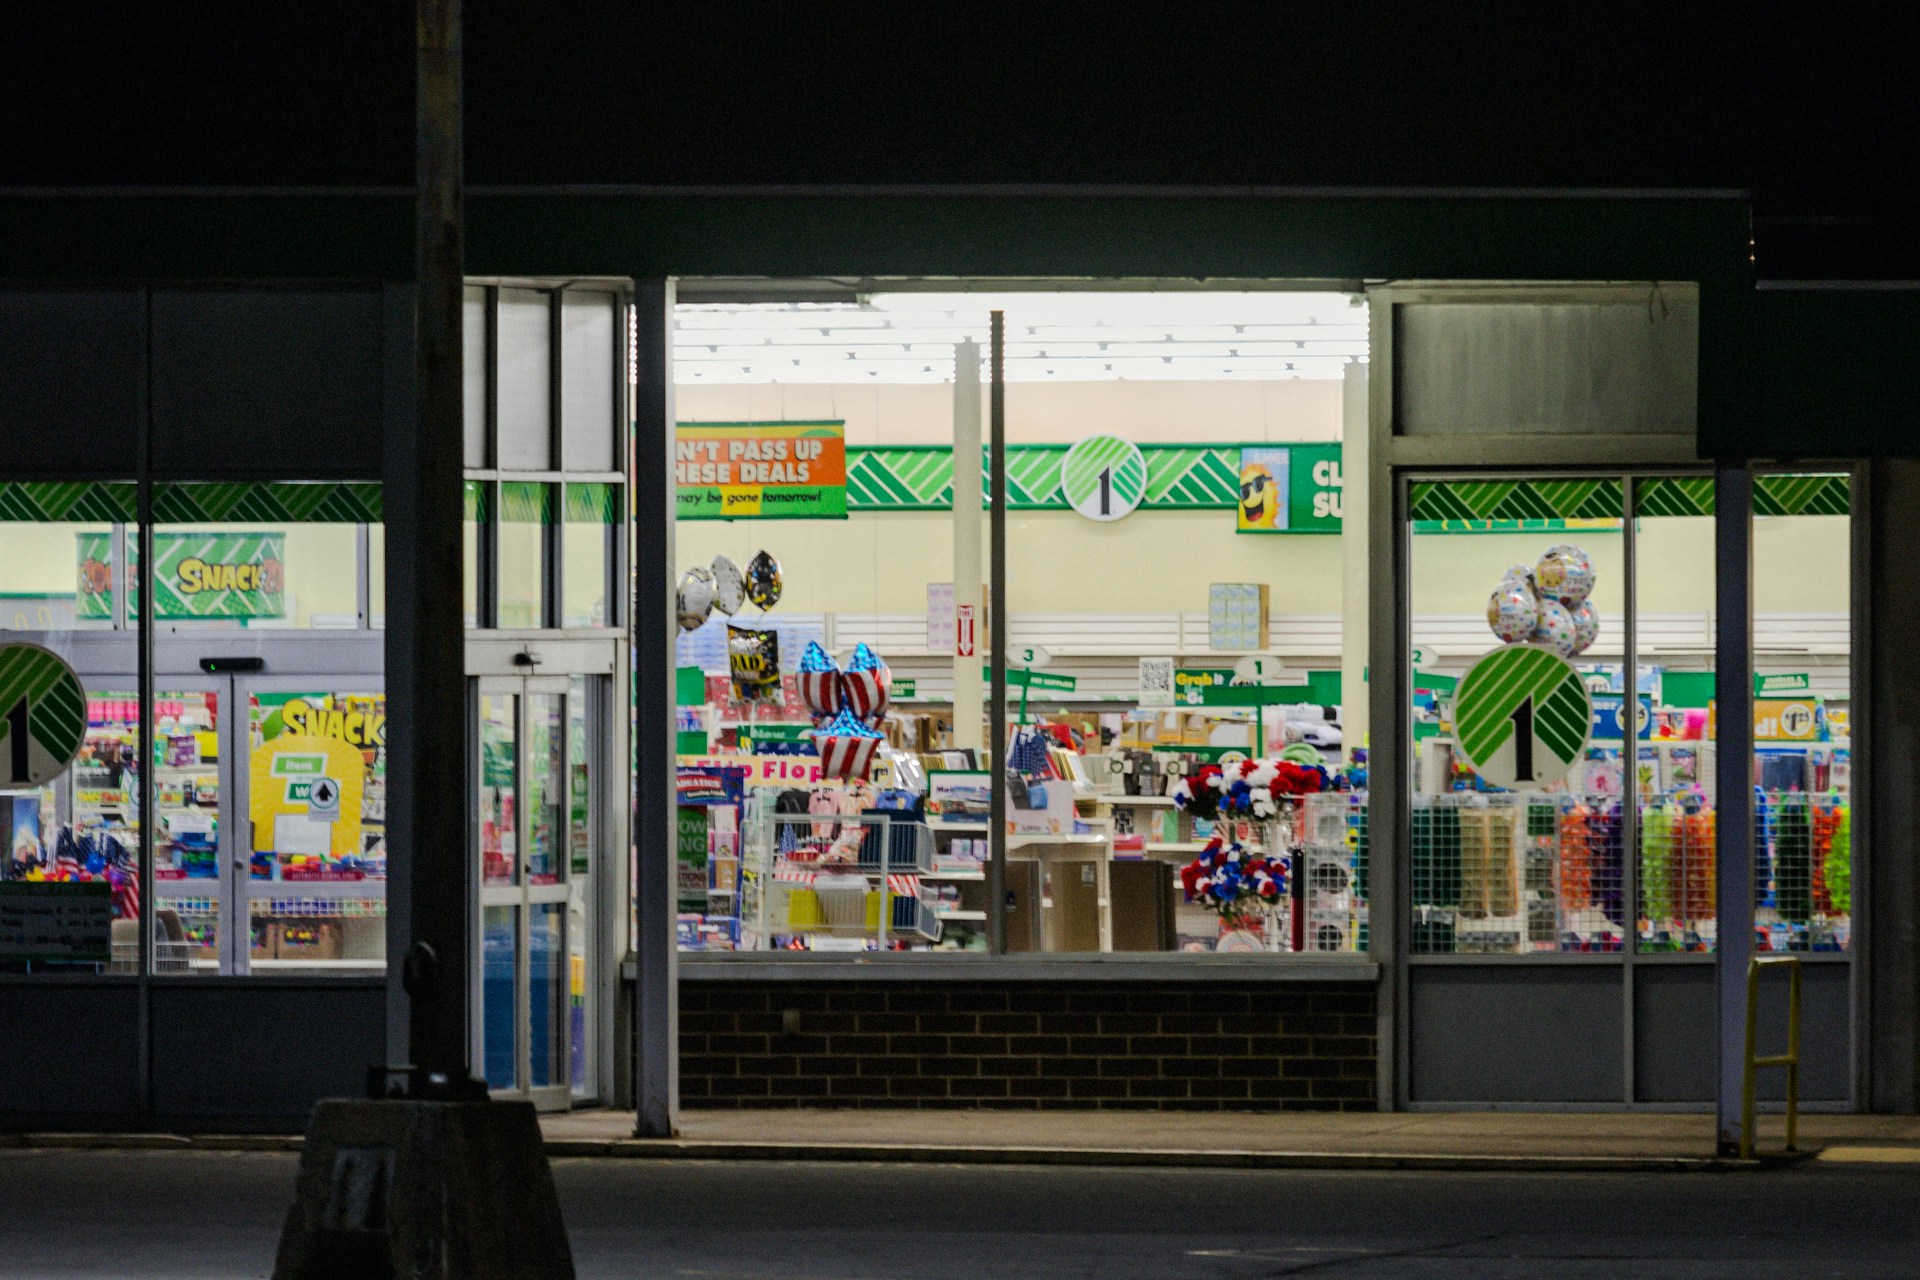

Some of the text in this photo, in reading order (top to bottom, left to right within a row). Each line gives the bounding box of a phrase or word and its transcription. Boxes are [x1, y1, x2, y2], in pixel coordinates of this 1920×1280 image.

[728, 440, 787, 461] PASS
[795, 439, 823, 461] UP
[740, 461, 809, 483] DEALS
[707, 490, 722, 503] be
[727, 494, 758, 505] gone
[763, 489, 821, 502] tomorrow!
[1023, 649, 1034, 662] 3
[1413, 651, 1422, 663] 2
[1255, 661, 1262, 675] 1
[1176, 672, 1213, 686] Grab
[762, 761, 842, 783] Flop
